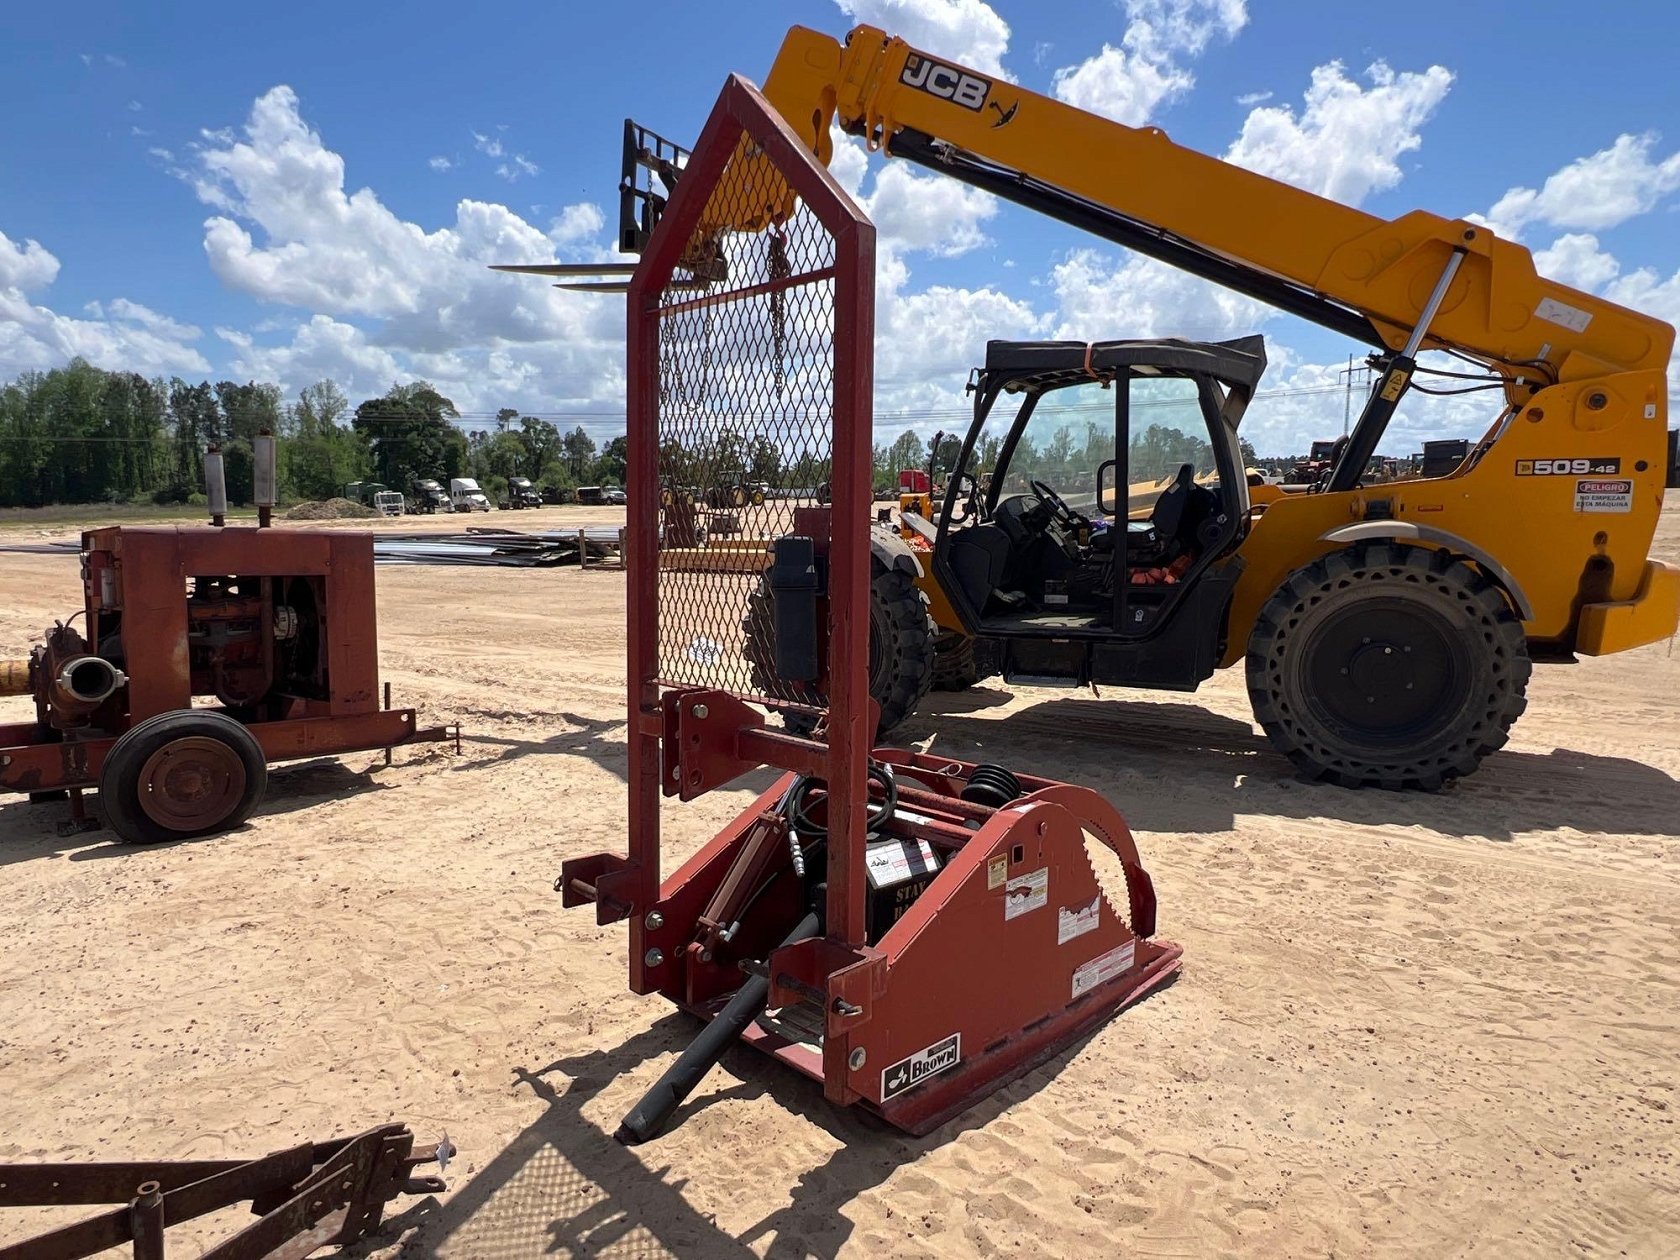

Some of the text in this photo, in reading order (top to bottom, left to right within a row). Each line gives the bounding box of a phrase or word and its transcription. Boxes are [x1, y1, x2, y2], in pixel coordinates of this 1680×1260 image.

[902, 60, 988, 109] JCB
[1533, 459, 1616, 475] 509-42
[1584, 483, 1625, 492] PELIGRO
[1594, 500, 1628, 508] MÁQUINA
[896, 881, 926, 903] STAY
